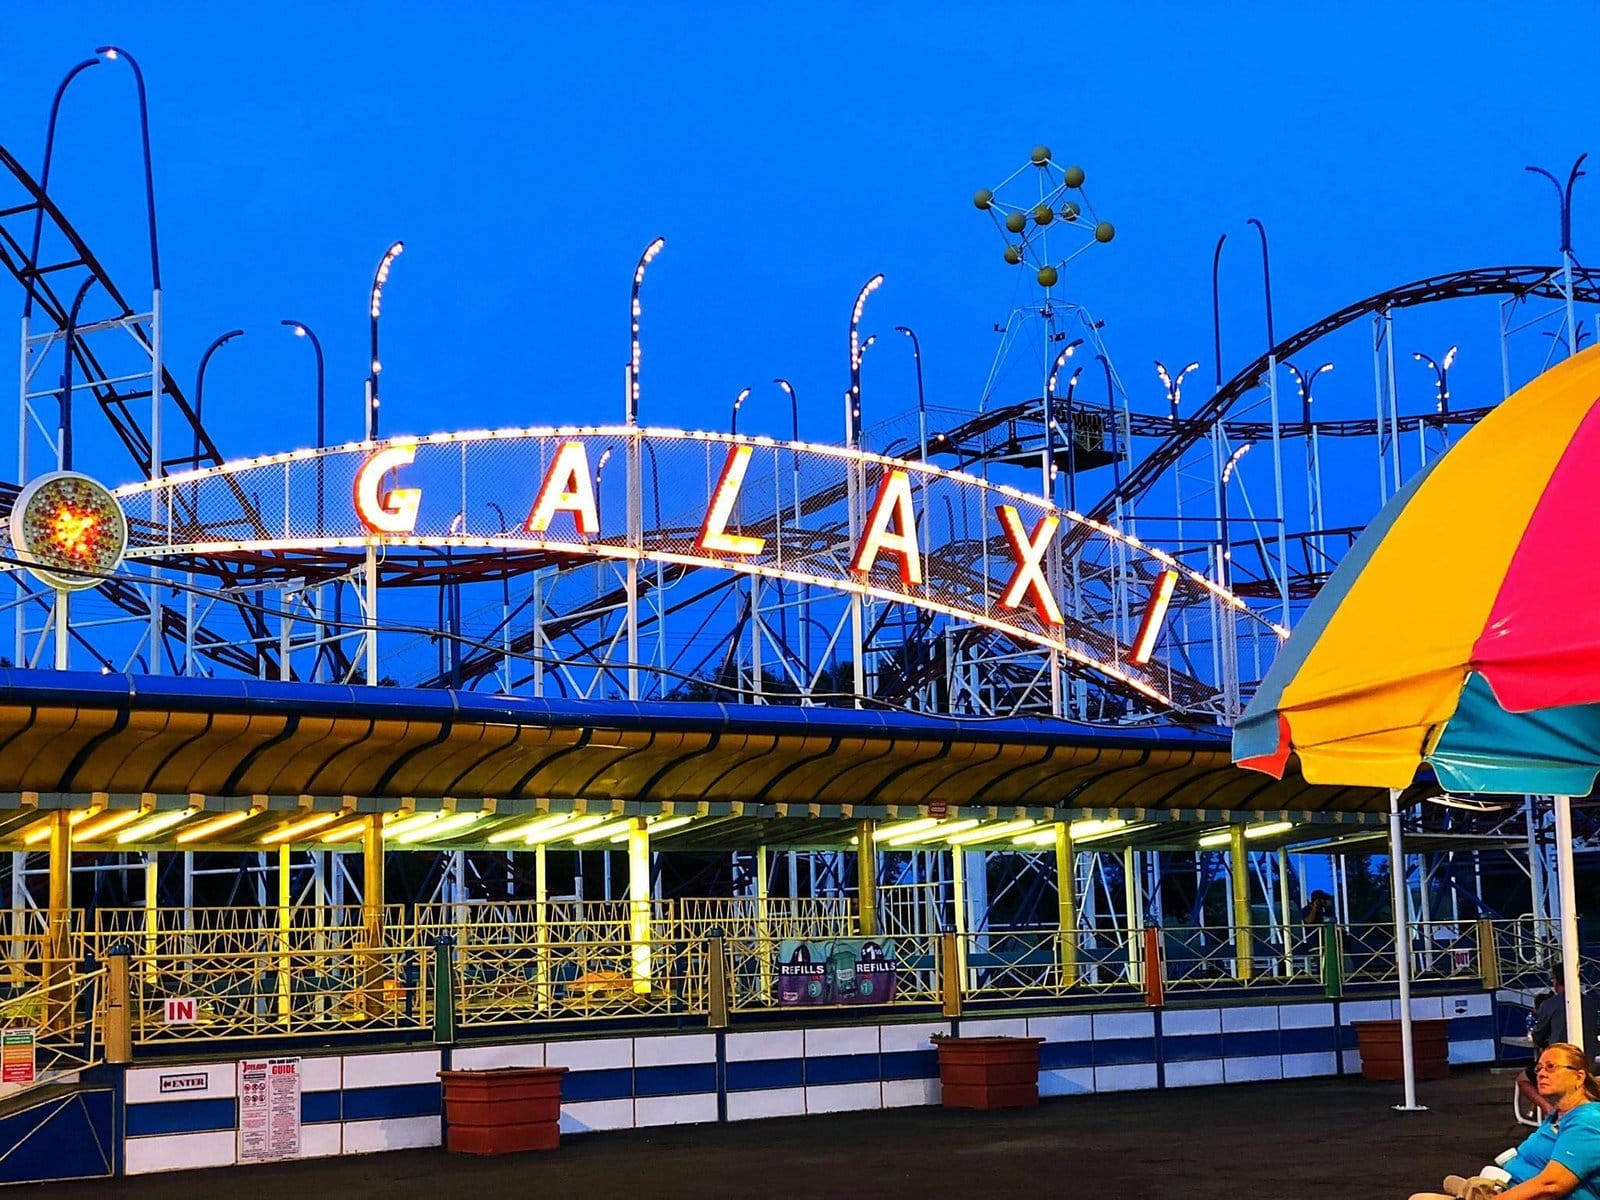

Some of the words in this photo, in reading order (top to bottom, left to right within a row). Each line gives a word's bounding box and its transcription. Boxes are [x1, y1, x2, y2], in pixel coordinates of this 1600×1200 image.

[353, 440, 1178, 665] GALAXI
[781, 964, 825, 975] REFILLS
[856, 961, 896, 973] REFILLS
[169, 1001, 193, 1020] IN
[272, 1064, 295, 1075] GUIDE
[172, 1078, 204, 1088] ENTER
